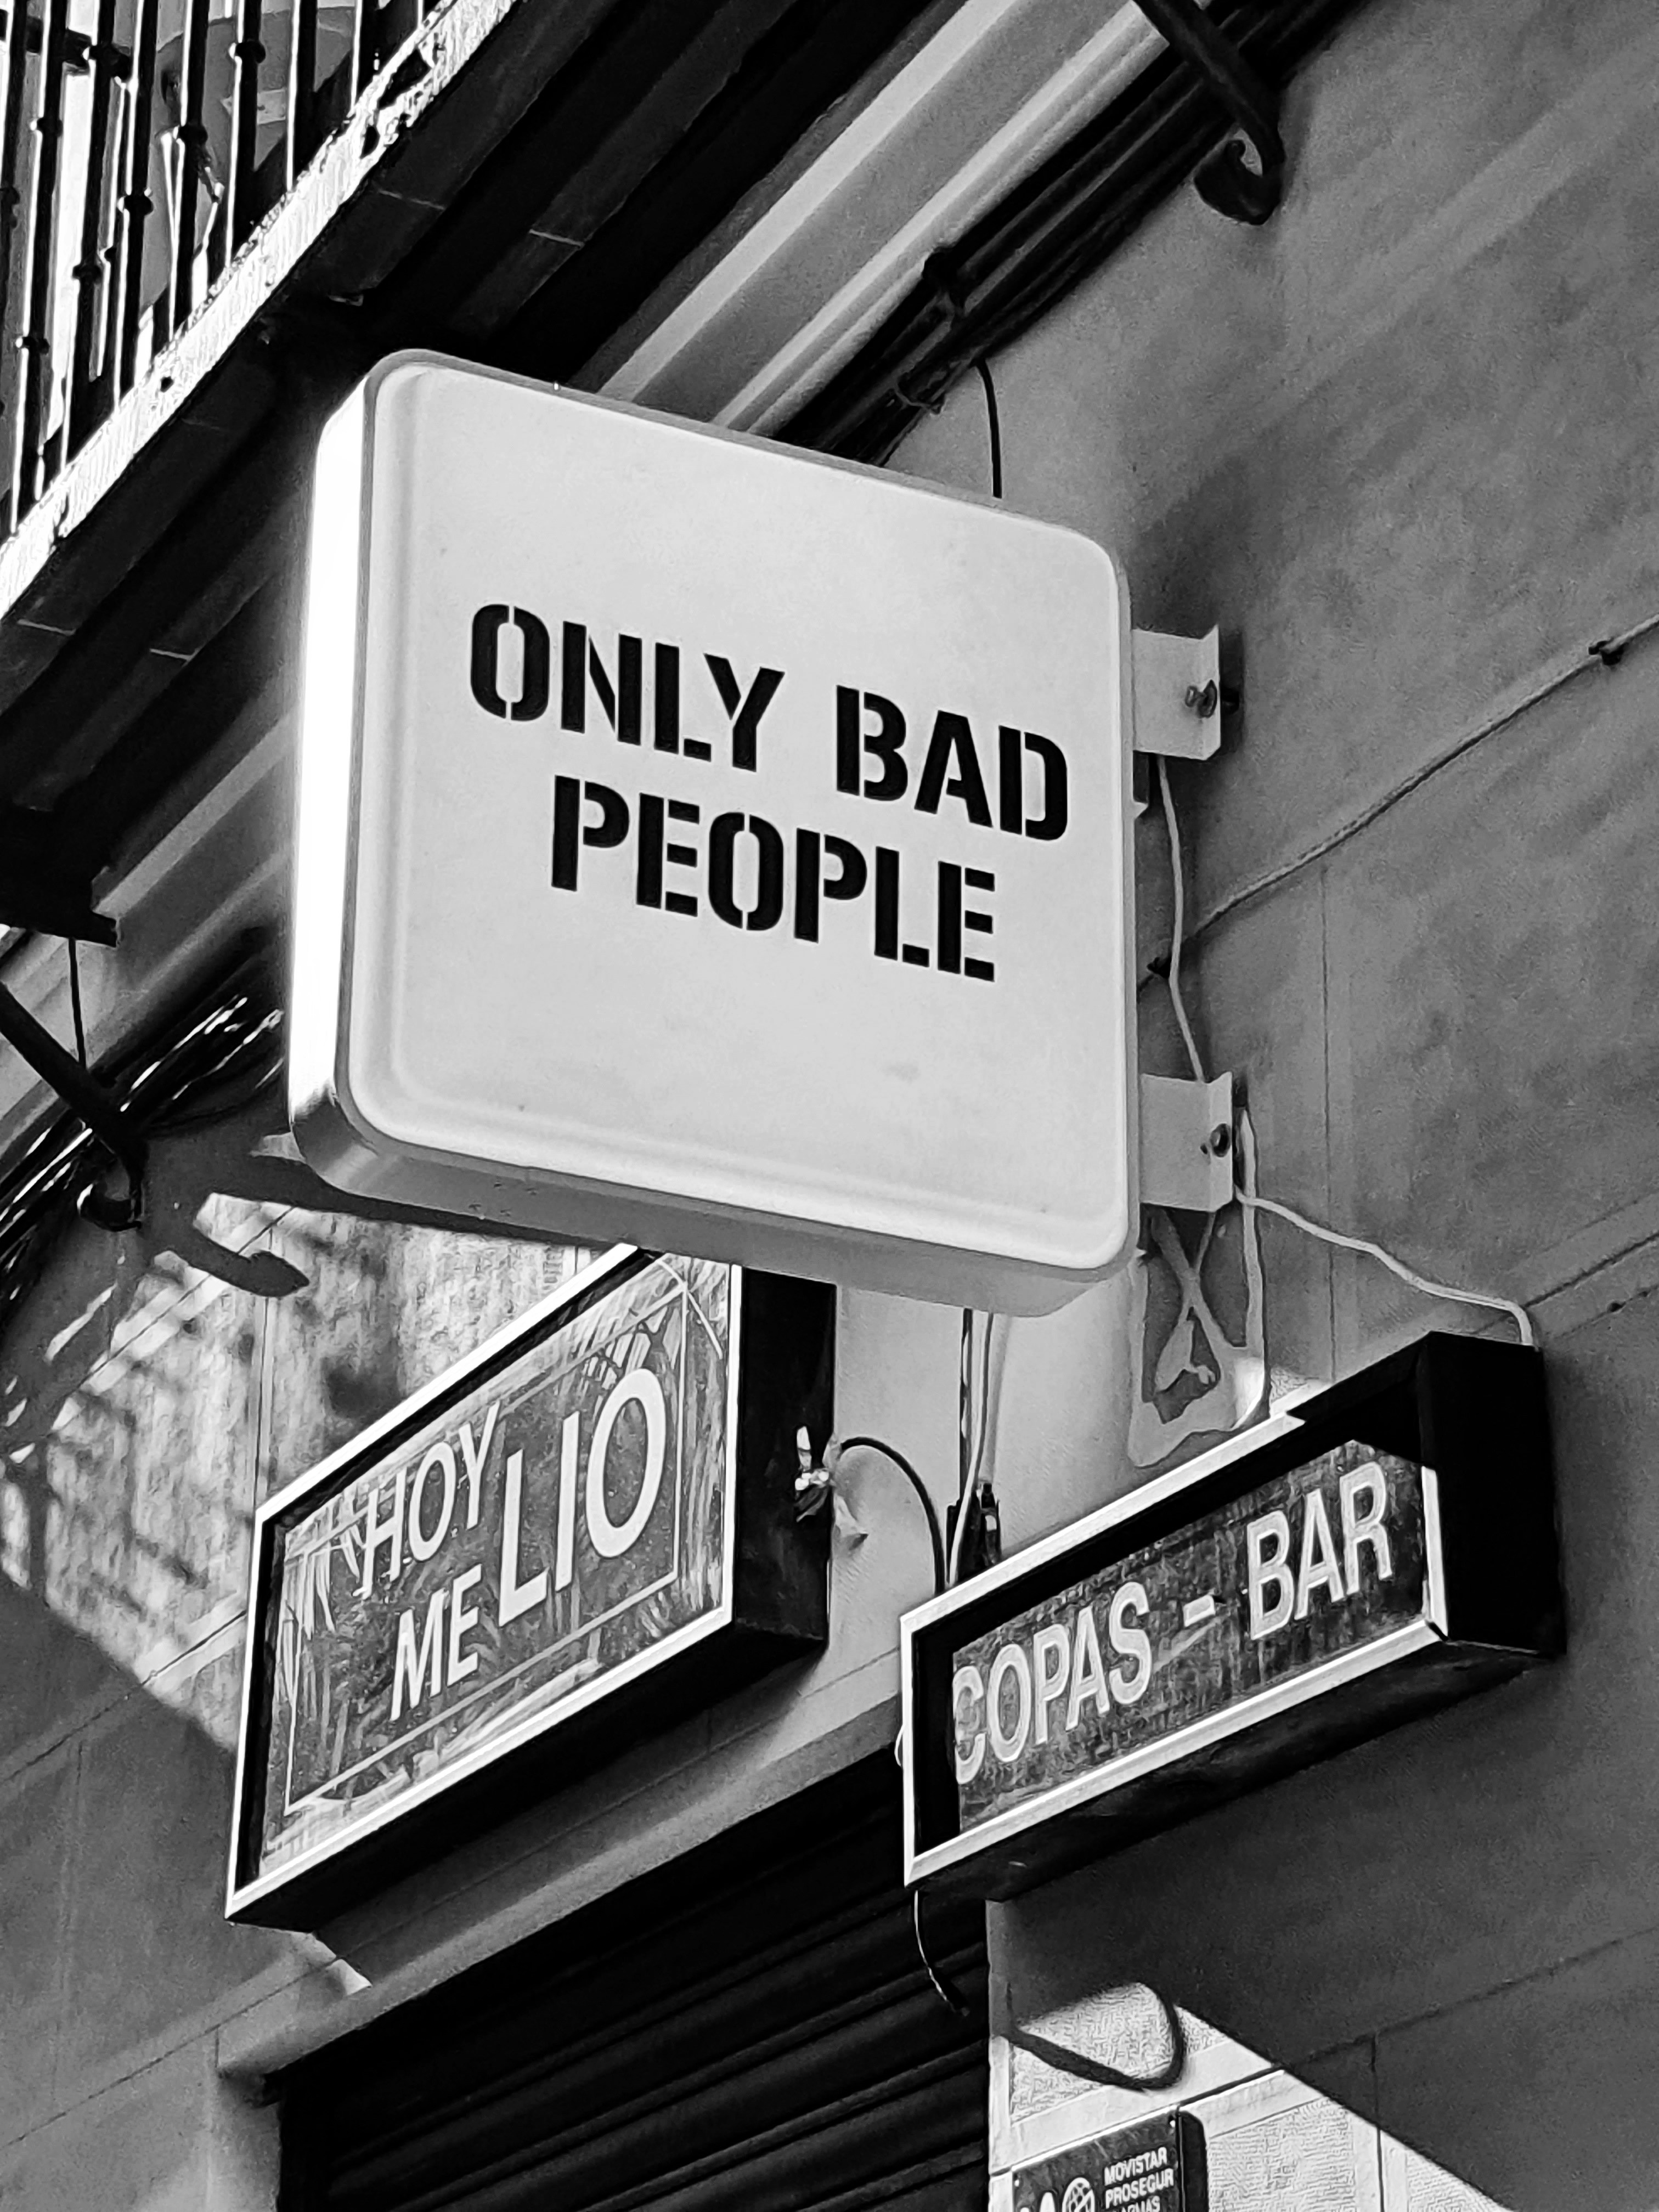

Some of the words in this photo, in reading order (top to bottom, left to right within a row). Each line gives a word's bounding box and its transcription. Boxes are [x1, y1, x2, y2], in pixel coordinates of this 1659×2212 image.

[471, 604, 785, 772] ONLY
[836, 684, 1068, 841] BAD
[551, 774, 995, 982] PEOPLE
[362, 1400, 500, 1600] HOY
[498, 1368, 666, 1627] LIO
[390, 1564, 482, 1722] ME
[952, 1582, 1151, 1784] COPAS
[1246, 1462, 1392, 1640] BAR
[1104, 2147, 1167, 2186] MOVISTAR
[1105, 2168, 1174, 2209] PROSEGUR
